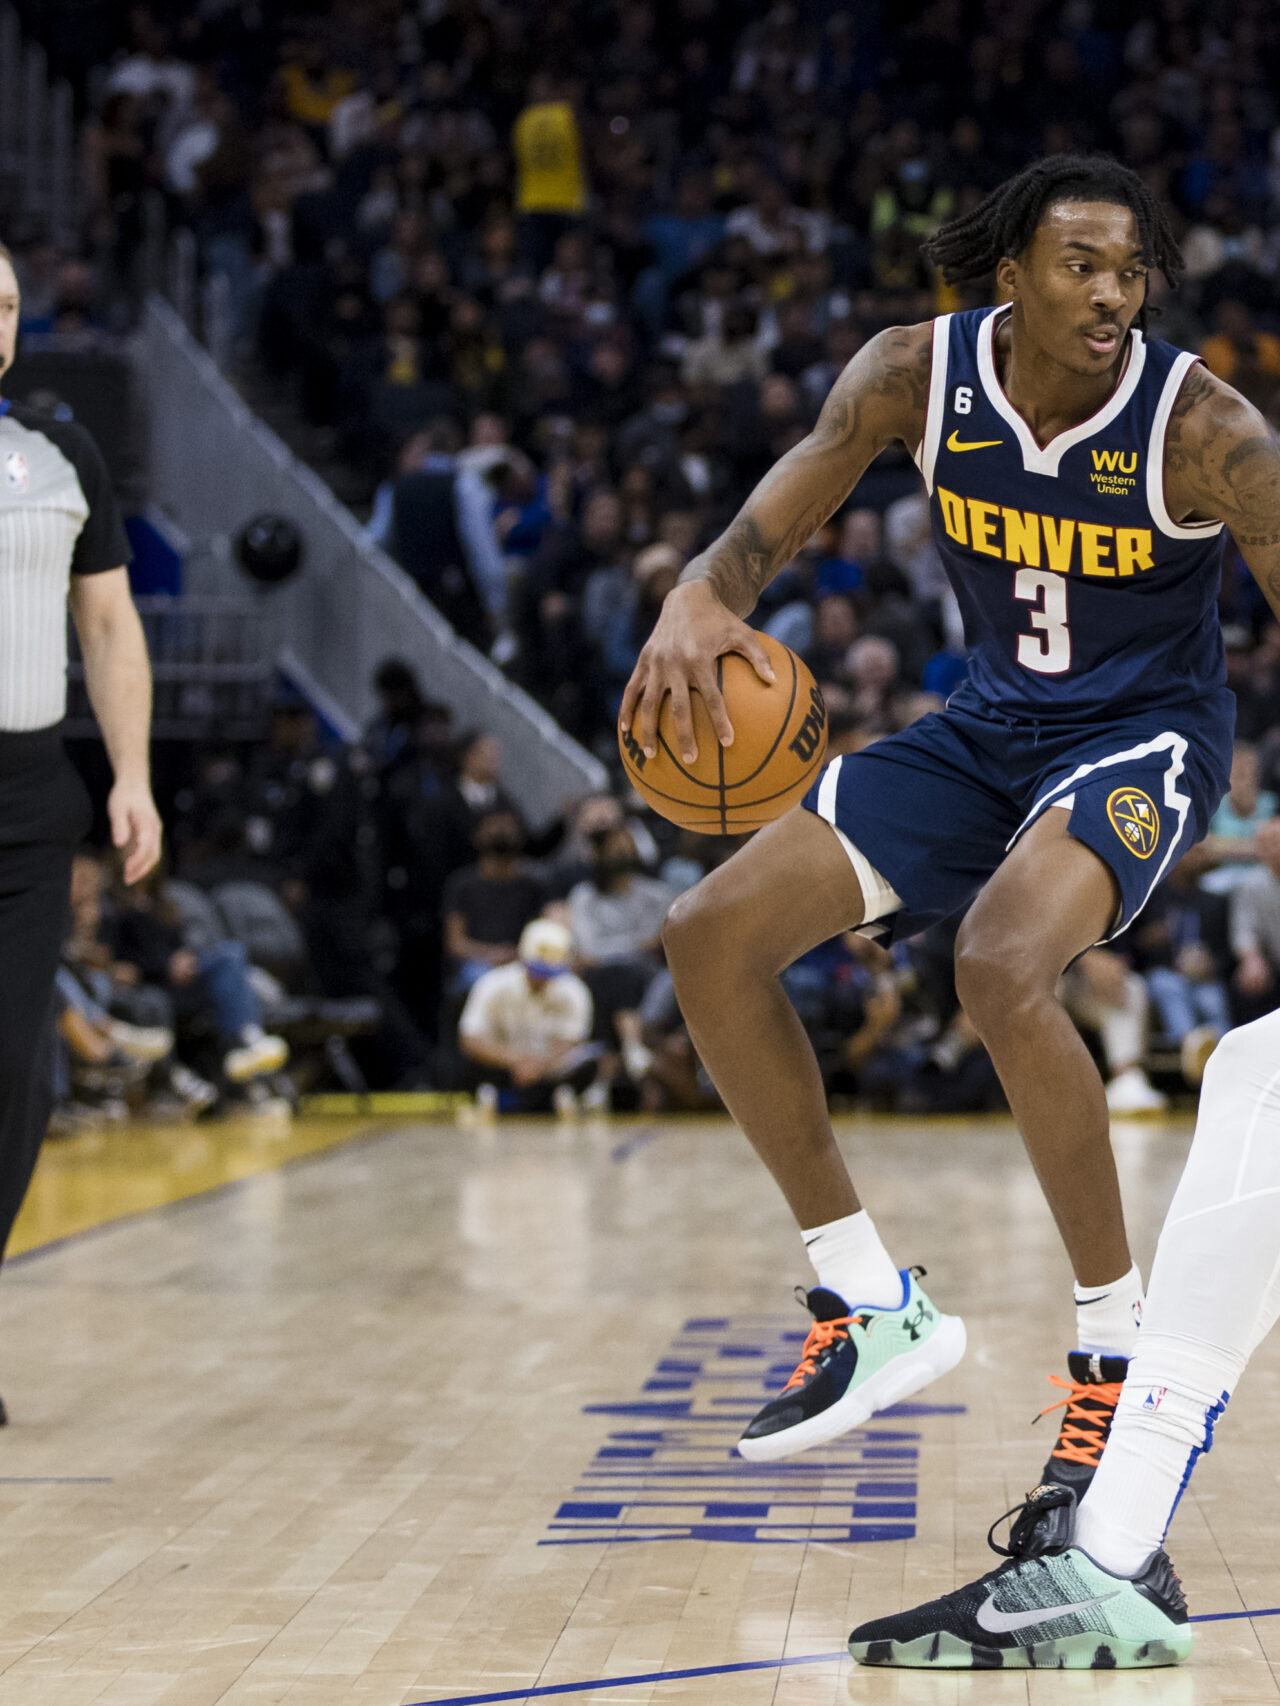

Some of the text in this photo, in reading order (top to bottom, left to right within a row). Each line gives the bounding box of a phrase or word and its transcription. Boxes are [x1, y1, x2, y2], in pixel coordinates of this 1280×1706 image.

[954, 387, 973, 415] 6
[1091, 450, 1138, 474] WU
[1090, 473, 1136, 486] Western
[1097, 484, 1129, 496] Union
[937, 485, 1155, 577] DENVER
[1014, 567, 1071, 674] 3
